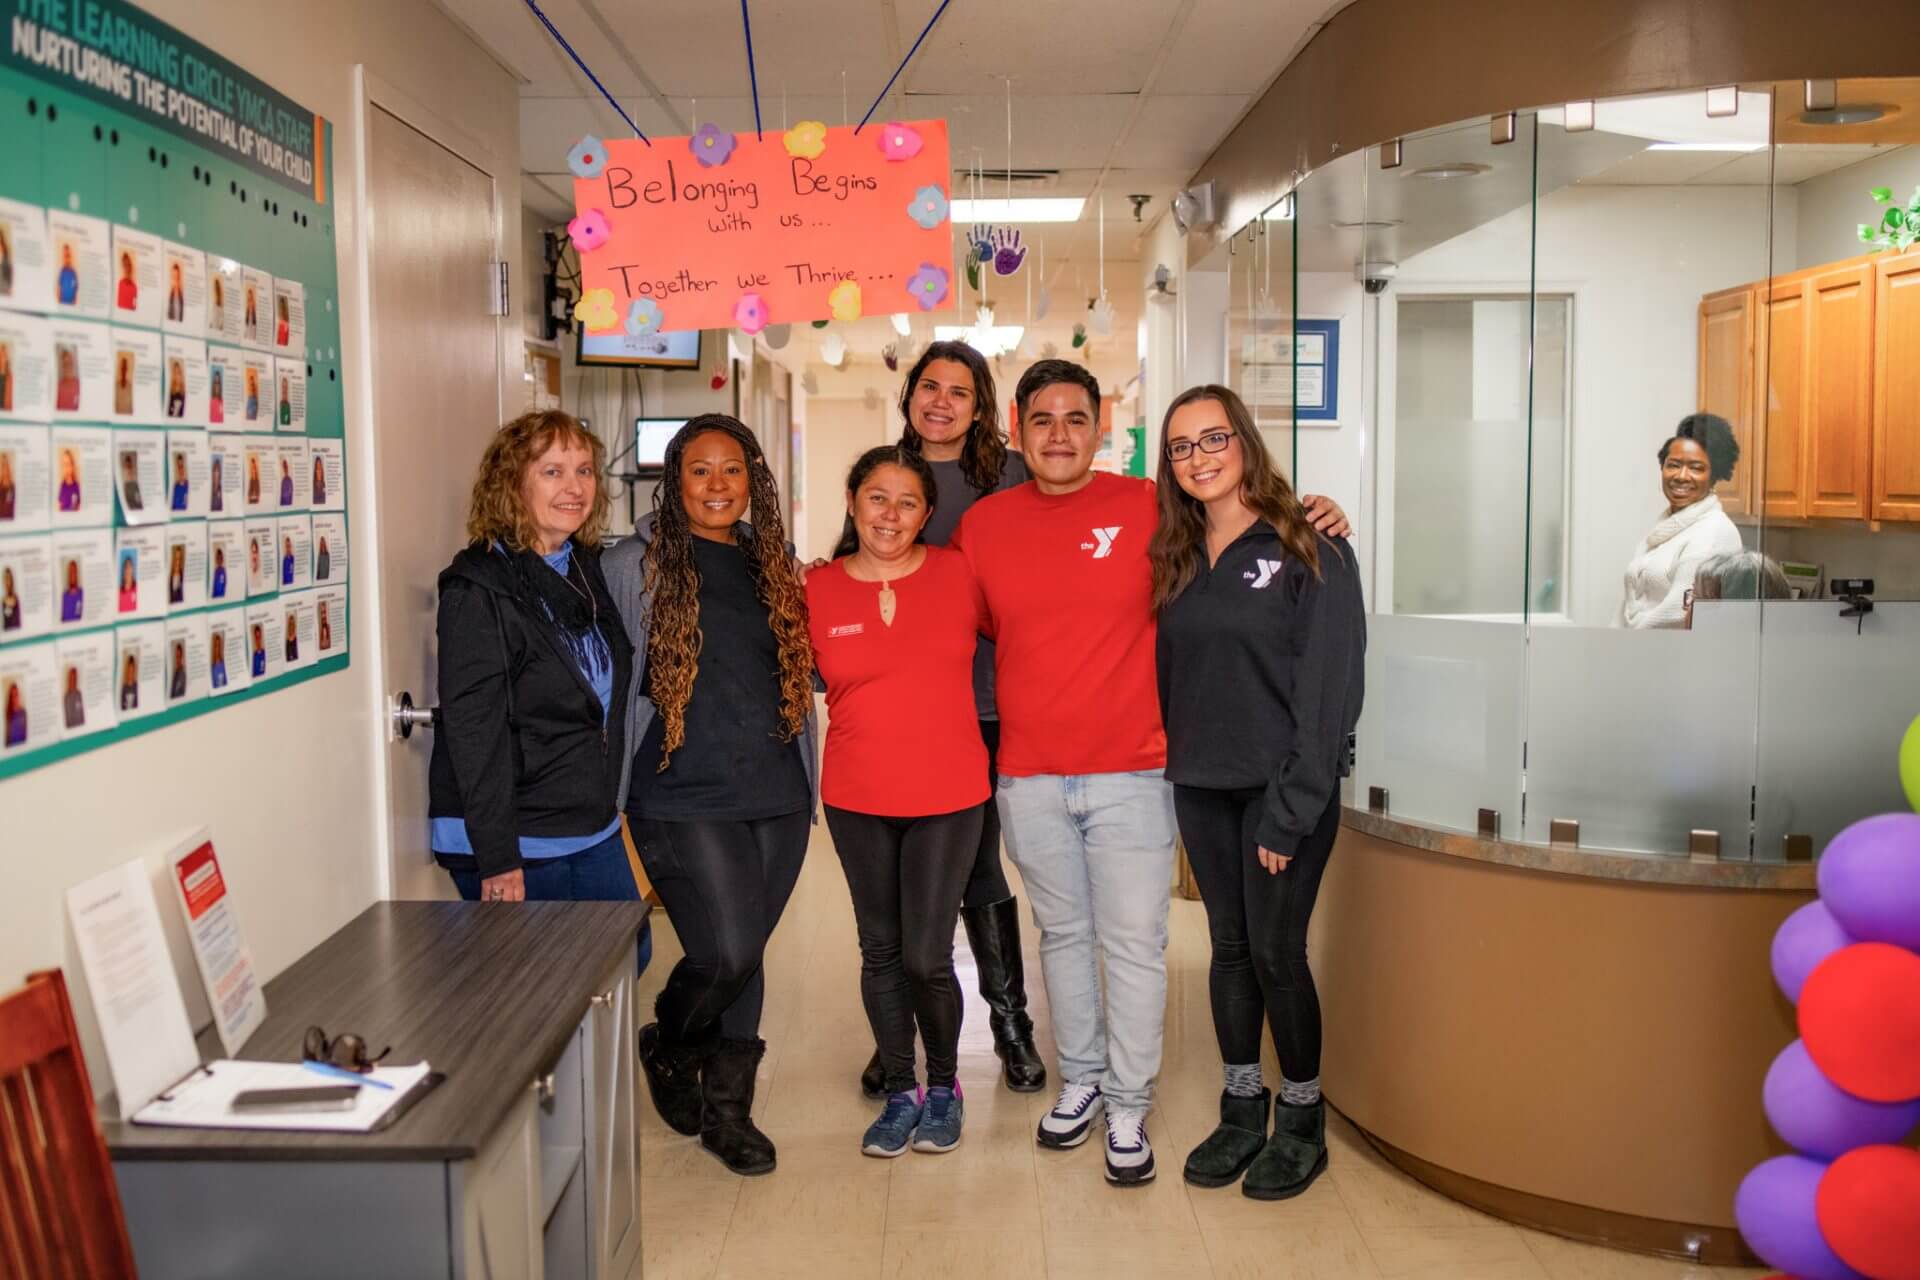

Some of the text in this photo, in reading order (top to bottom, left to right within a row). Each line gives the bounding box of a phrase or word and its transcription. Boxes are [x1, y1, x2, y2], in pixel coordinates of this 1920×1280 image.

[12, 15, 312, 185] NURTURING THE POTENTIAL OF YOUR CHILD
[72, 0, 179, 86] LEARNING
[182, 55, 234, 115] CIRCLE
[236, 84, 274, 137] YMCA
[277, 110, 312, 154] STAFF
[606, 157, 878, 212] Belonging Begins
[607, 264, 718, 299] Together
